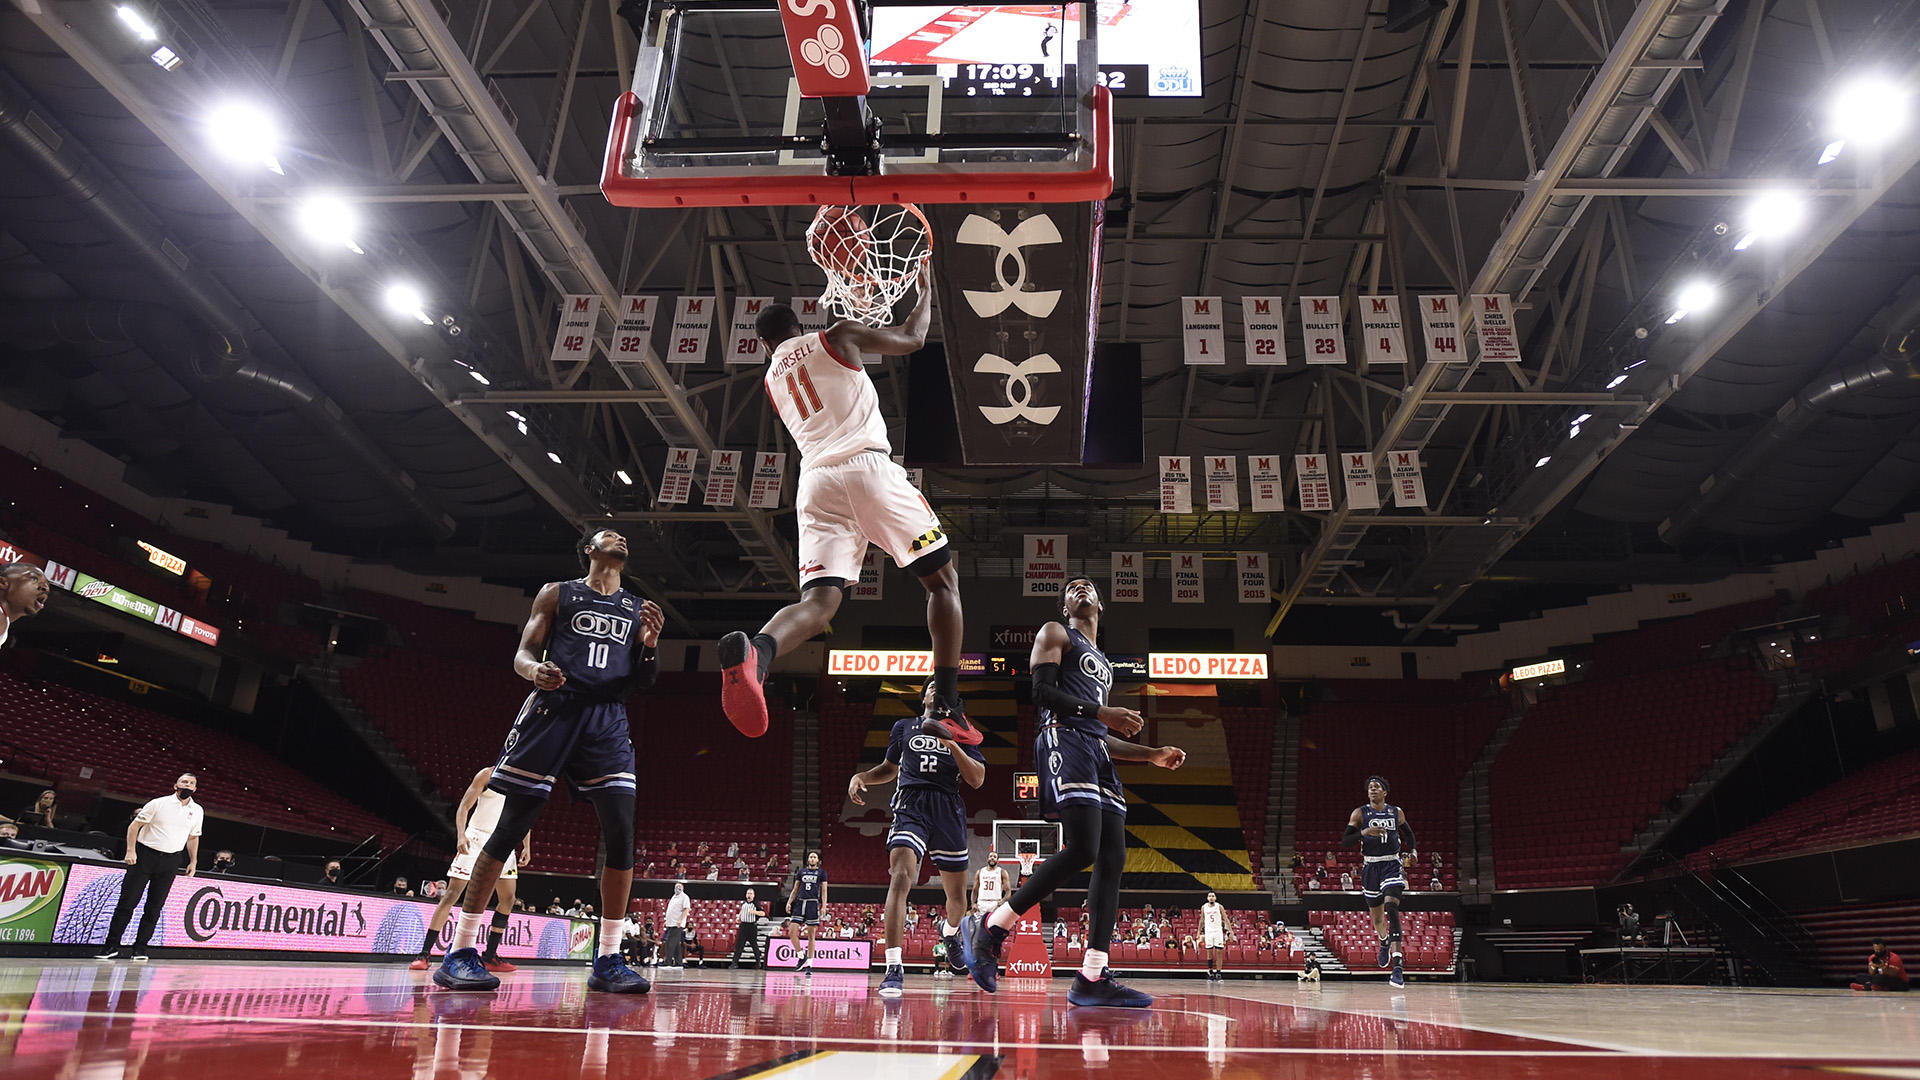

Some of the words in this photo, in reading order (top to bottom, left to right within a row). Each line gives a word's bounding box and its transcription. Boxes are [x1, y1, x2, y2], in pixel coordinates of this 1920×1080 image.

[967, 64, 1034, 80] 17:09
[967, 87, 976, 96] 3
[1023, 87, 1032, 96] 3
[574, 298, 590, 311] M
[631, 298, 647, 312] M
[687, 299, 703, 313] M
[745, 299, 761, 313] M
[802, 300, 818, 314] M
[1194, 299, 1210, 313] M
[1254, 299, 1270, 313] M
[1313, 299, 1328, 313] M
[1372, 298, 1388, 312] M
[1431, 298, 1447, 312] M
[1483, 297, 1500, 311] M
[1306, 322, 1339, 330] BULLETT
[1365, 321, 1400, 329] PERAZIC
[563, 336, 584, 351] 42
[620, 337, 641, 352] 32
[678, 338, 699, 353] 25
[737, 338, 758, 354] 20
[1200, 339, 1209, 354] 1
[1256, 339, 1276, 355] 22
[1315, 338, 1336, 354] 23
[1380, 338, 1391, 353] 4
[1435, 337, 1457, 353] 44
[772, 343, 814, 380] MORSELL
[786, 363, 824, 421] 11
[676, 451, 689, 463] M
[719, 453, 733, 465] M
[763, 455, 777, 467] M
[1214, 458, 1227, 470] M
[1258, 458, 1271, 470] M
[1306, 457, 1318, 469] M
[1352, 455, 1365, 467] M
[1398, 453, 1411, 466] M
[1169, 459, 1181, 470] M
[1036, 539, 1055, 556] M
[160, 554, 184, 573] PIZZA
[1029, 563, 1062, 571] NATIONAL
[1122, 555, 1133, 566] M
[1181, 555, 1193, 567] M
[1247, 555, 1259, 567] M
[53, 563, 70, 585] M
[1025, 571, 1065, 579] CHAMPIONS
[1031, 582, 1059, 593] 2006
[1177, 589, 1199, 598] 2014
[1244, 589, 1265, 599] 2015
[161, 608, 177, 627] M
[194, 626, 217, 641] TOYOTA
[571, 610, 632, 645] ODU
[587, 641, 610, 669] 10
[832, 655, 880, 672] LEDO
[959, 659, 981, 667] planet
[993, 662, 1005, 671] 51
[1152, 657, 1201, 675] LEDO
[1208, 658, 1264, 676] PIZZA
[1514, 666, 1536, 678] LEDO
[1537, 662, 1563, 674] PIZZA
[909, 734, 952, 756] ODU
[920, 754, 938, 773] 22
[983, 880, 995, 891] 30
[184, 886, 347, 942] Continental
[15, 928, 35, 942] 1896
[1009, 959, 1049, 975] xfinity
